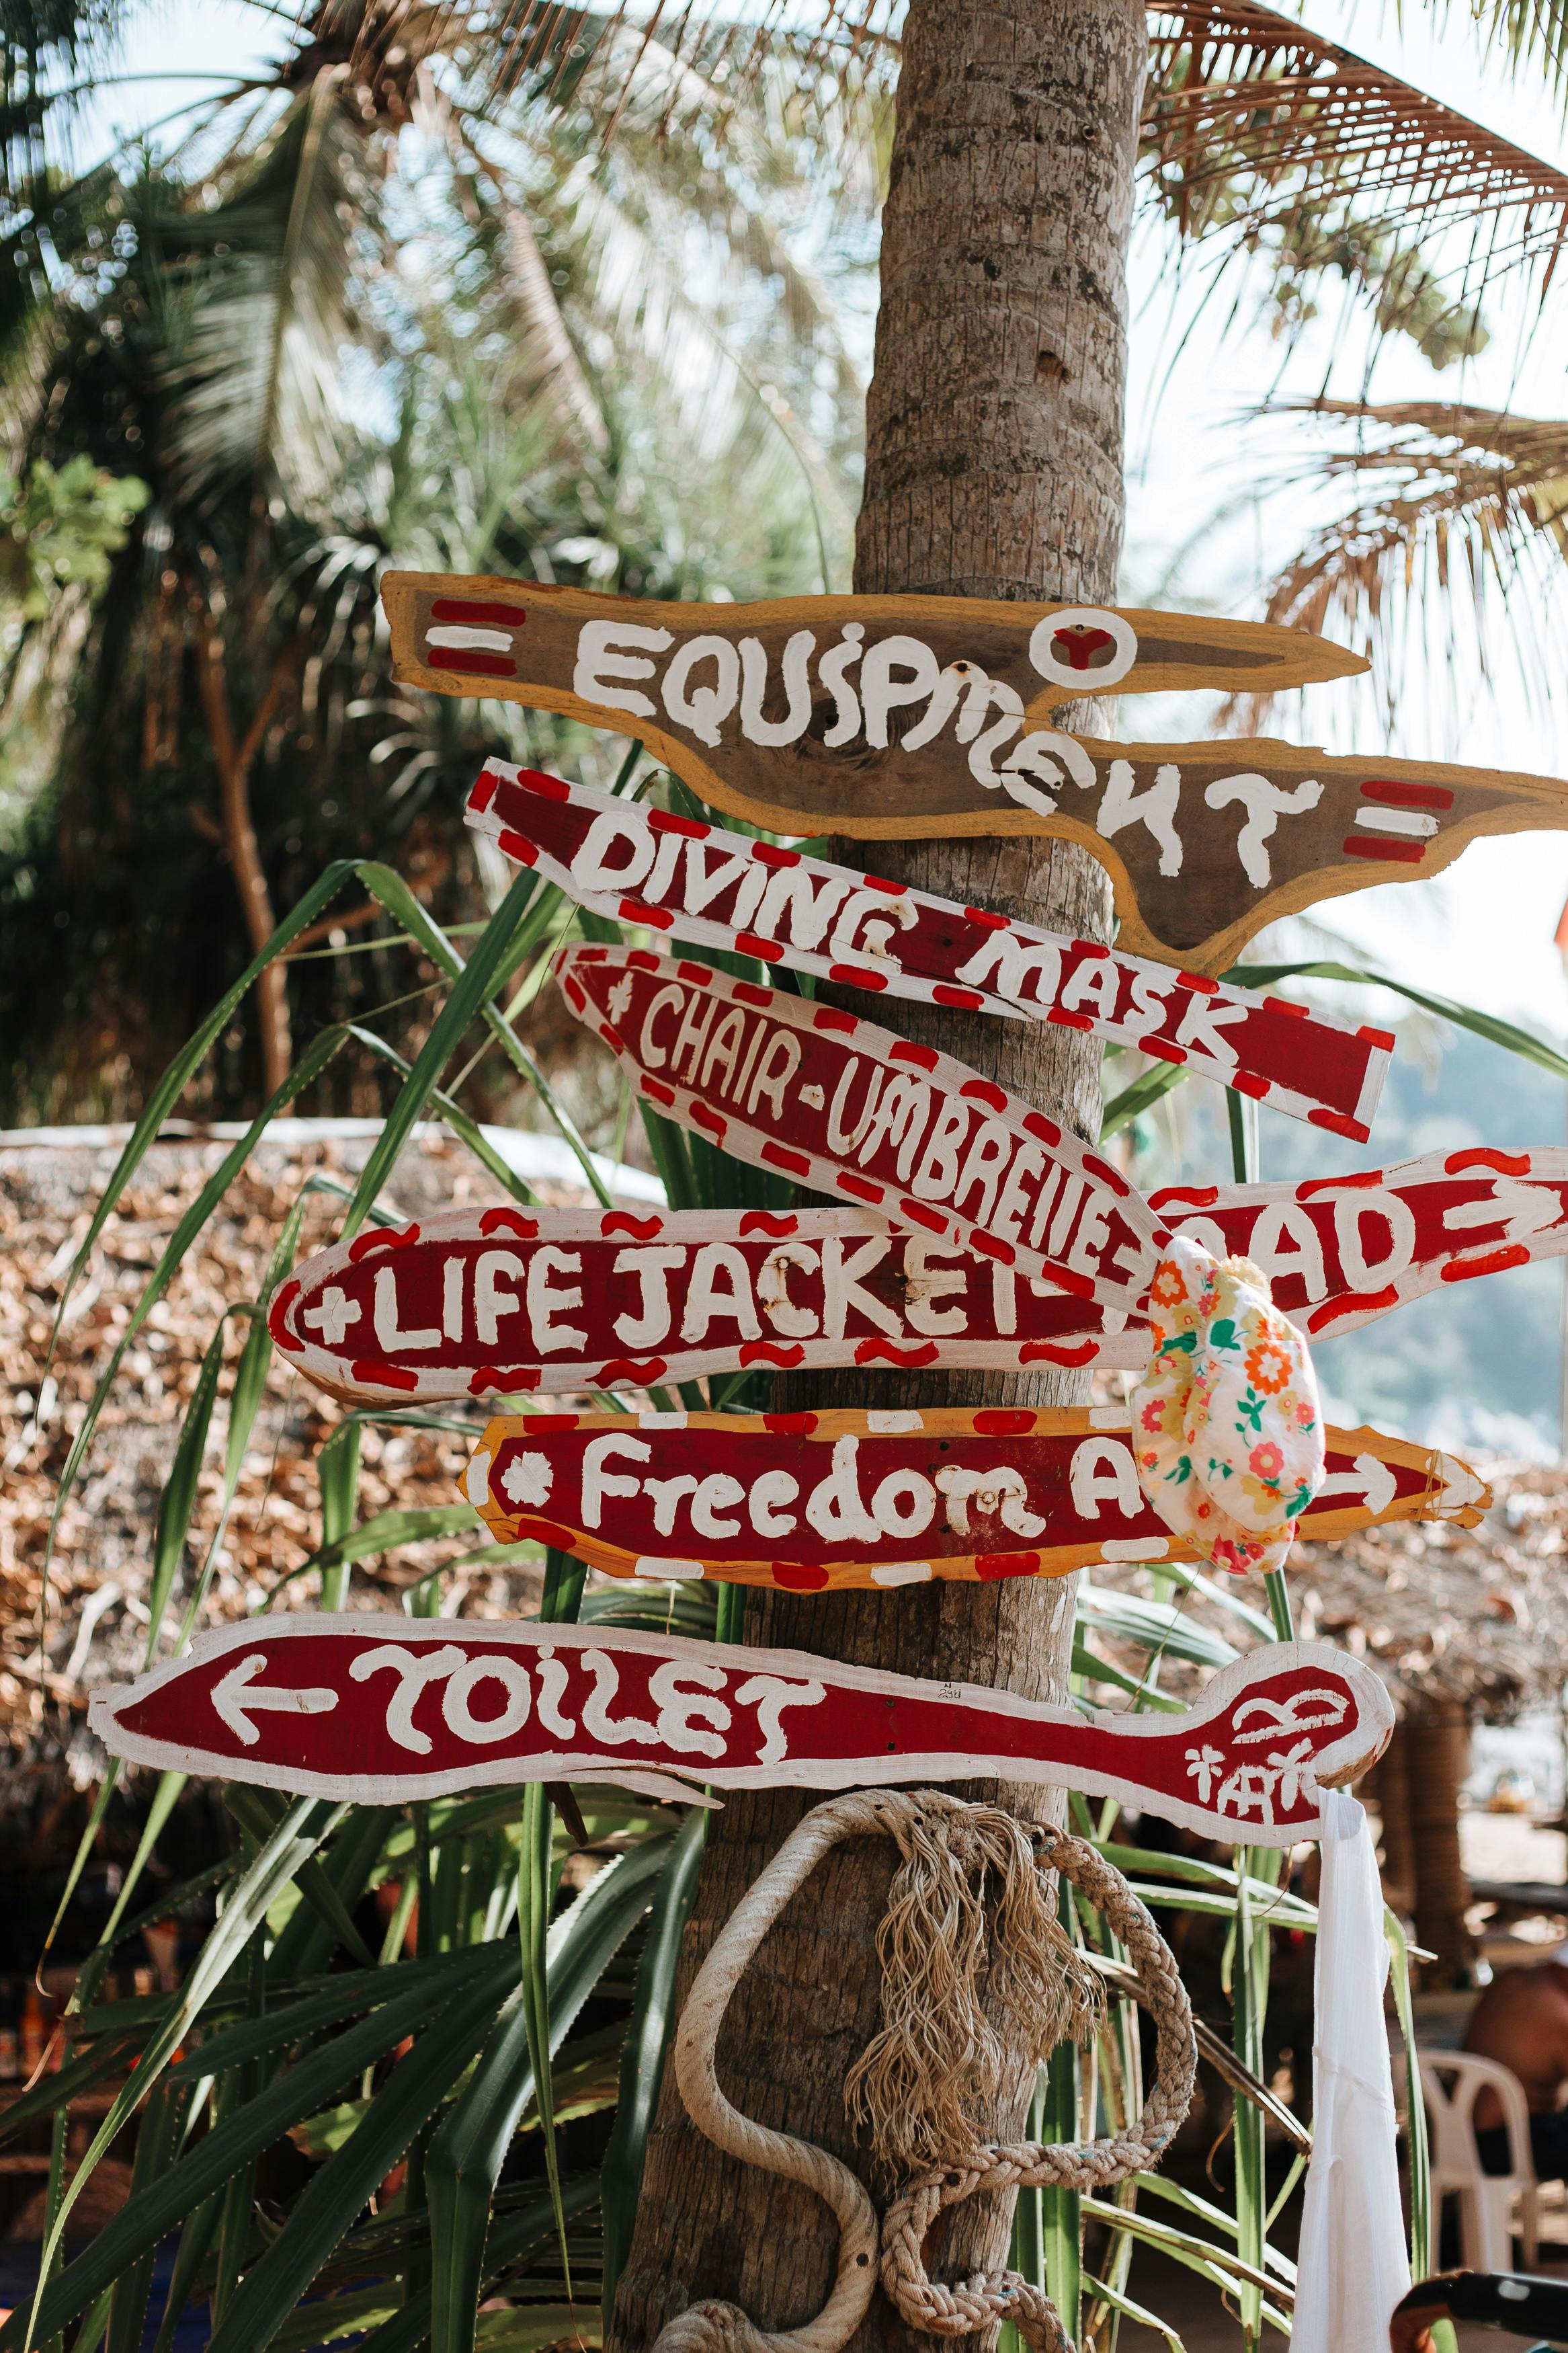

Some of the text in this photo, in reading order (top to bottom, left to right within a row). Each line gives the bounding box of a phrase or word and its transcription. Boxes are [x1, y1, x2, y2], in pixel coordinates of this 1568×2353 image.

[571, 811, 1249, 1067] DIVING MASK
[374, 1245, 589, 1355] LIFE
[582, 1433, 1046, 1543] Freedom
